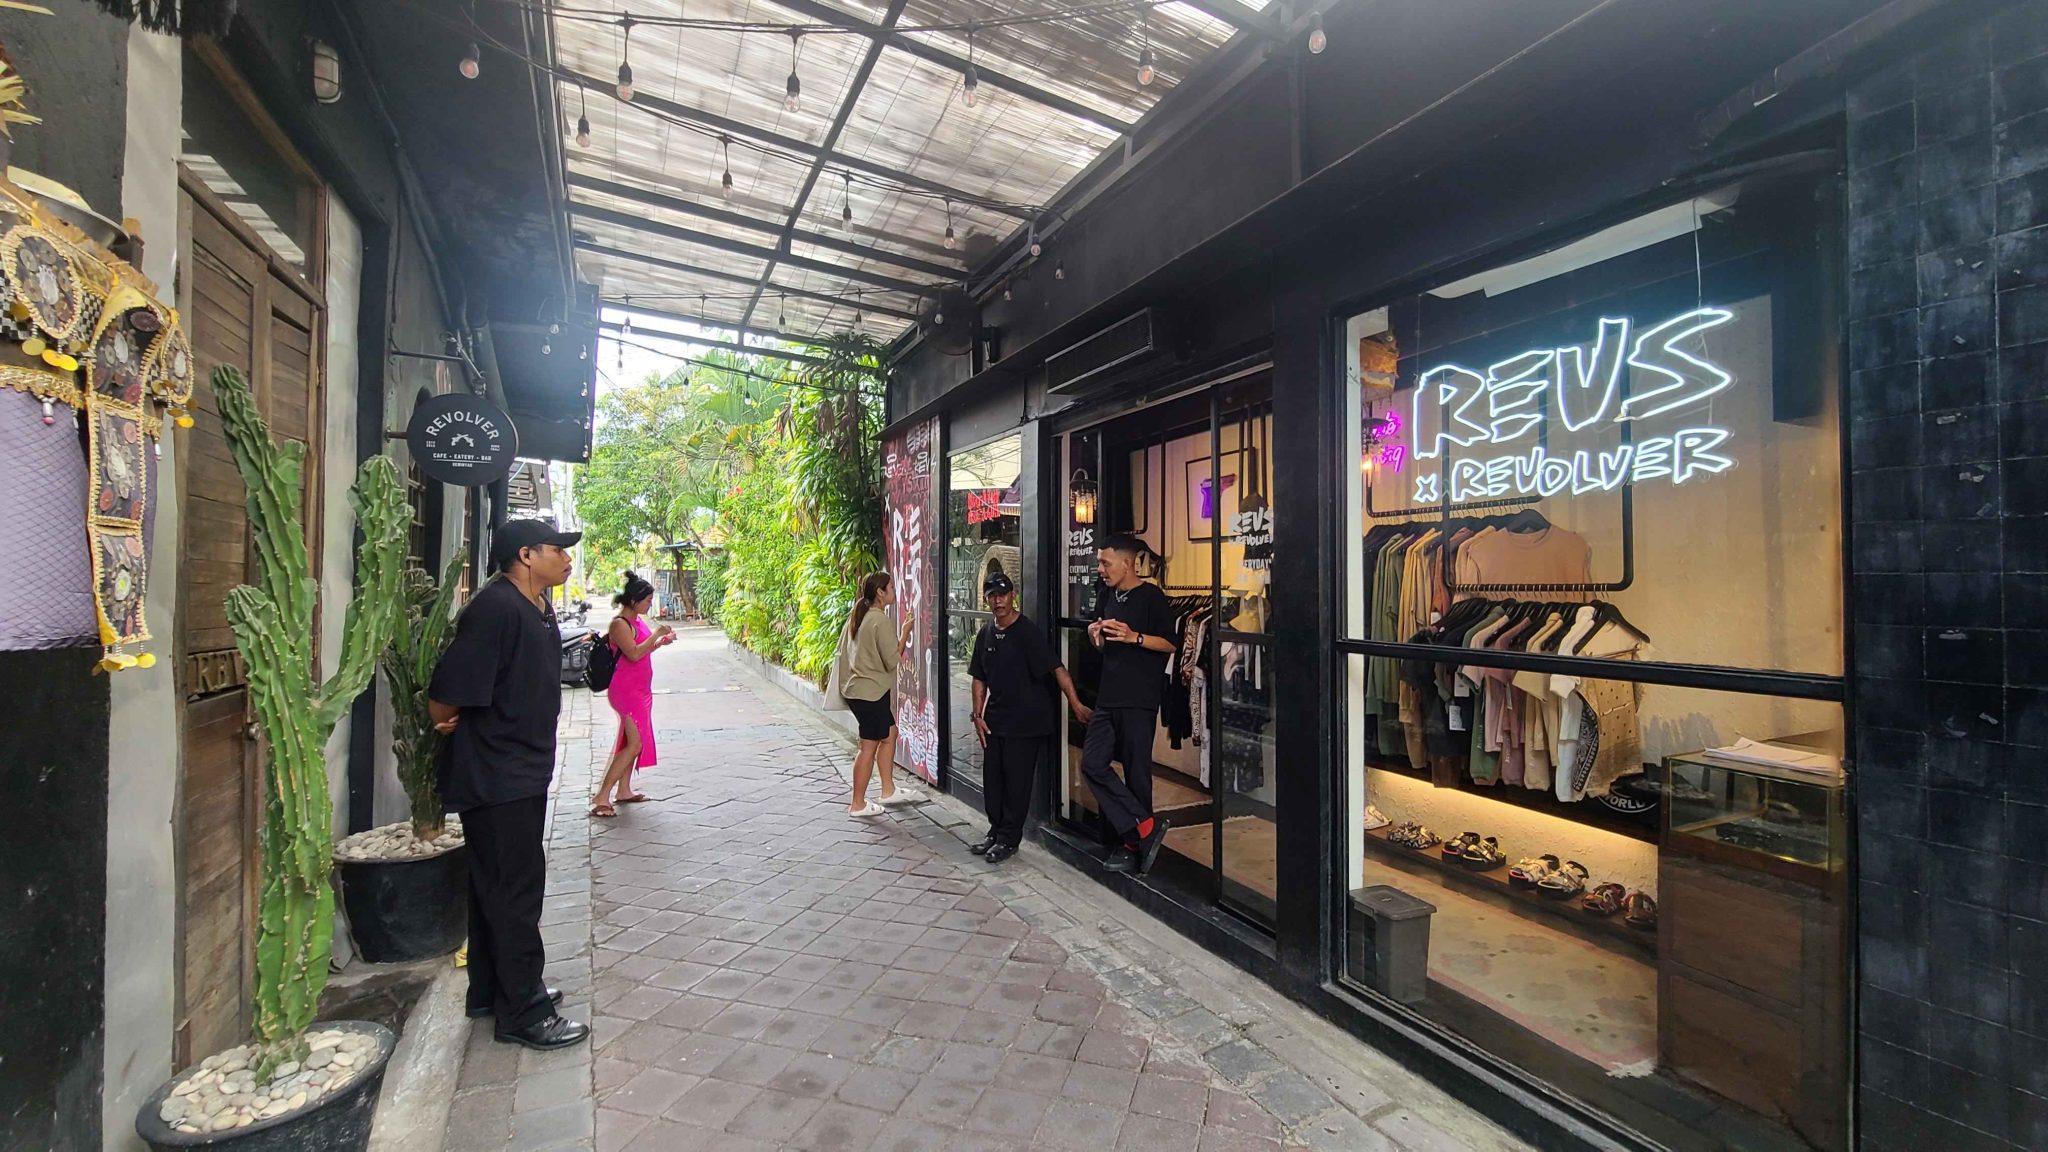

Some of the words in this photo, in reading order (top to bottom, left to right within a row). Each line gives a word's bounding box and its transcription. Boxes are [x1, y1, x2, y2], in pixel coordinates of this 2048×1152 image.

[1413, 308, 1733, 460] REVS
[426, 411, 499, 440] REVOLVER
[1451, 429, 1733, 502] REVOLVER
